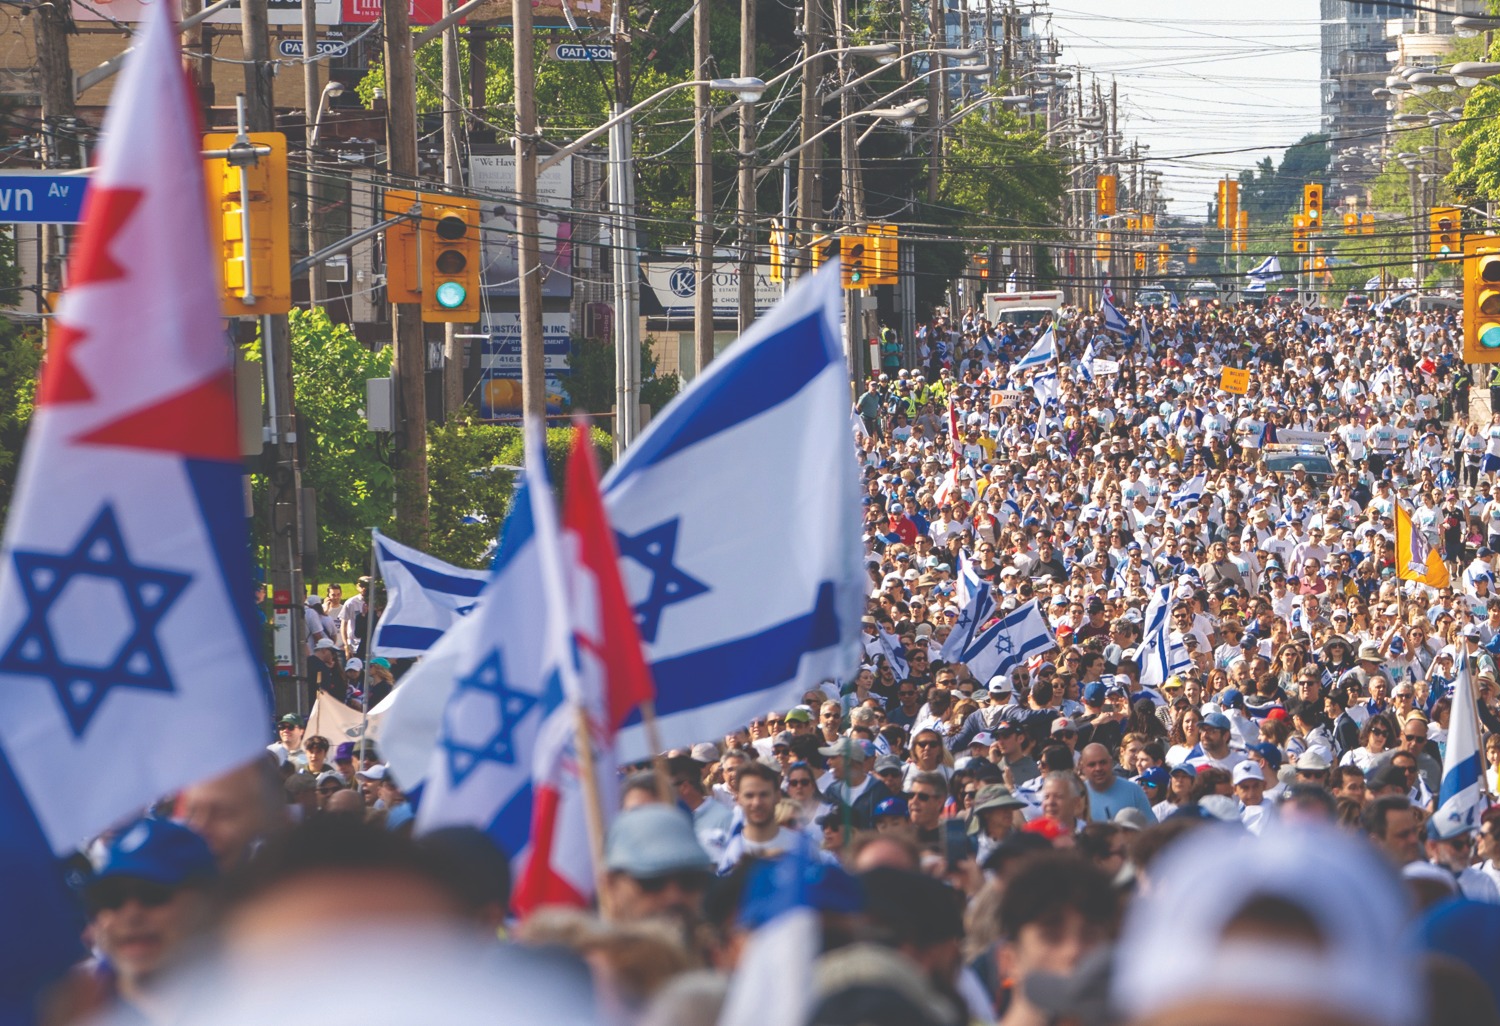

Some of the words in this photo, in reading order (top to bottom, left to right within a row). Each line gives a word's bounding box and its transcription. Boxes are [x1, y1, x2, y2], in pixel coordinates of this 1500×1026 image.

[285, 43, 342, 54] PATSON
[561, 47, 614, 58] PATTSON
[47, 182, 70, 197] Av
